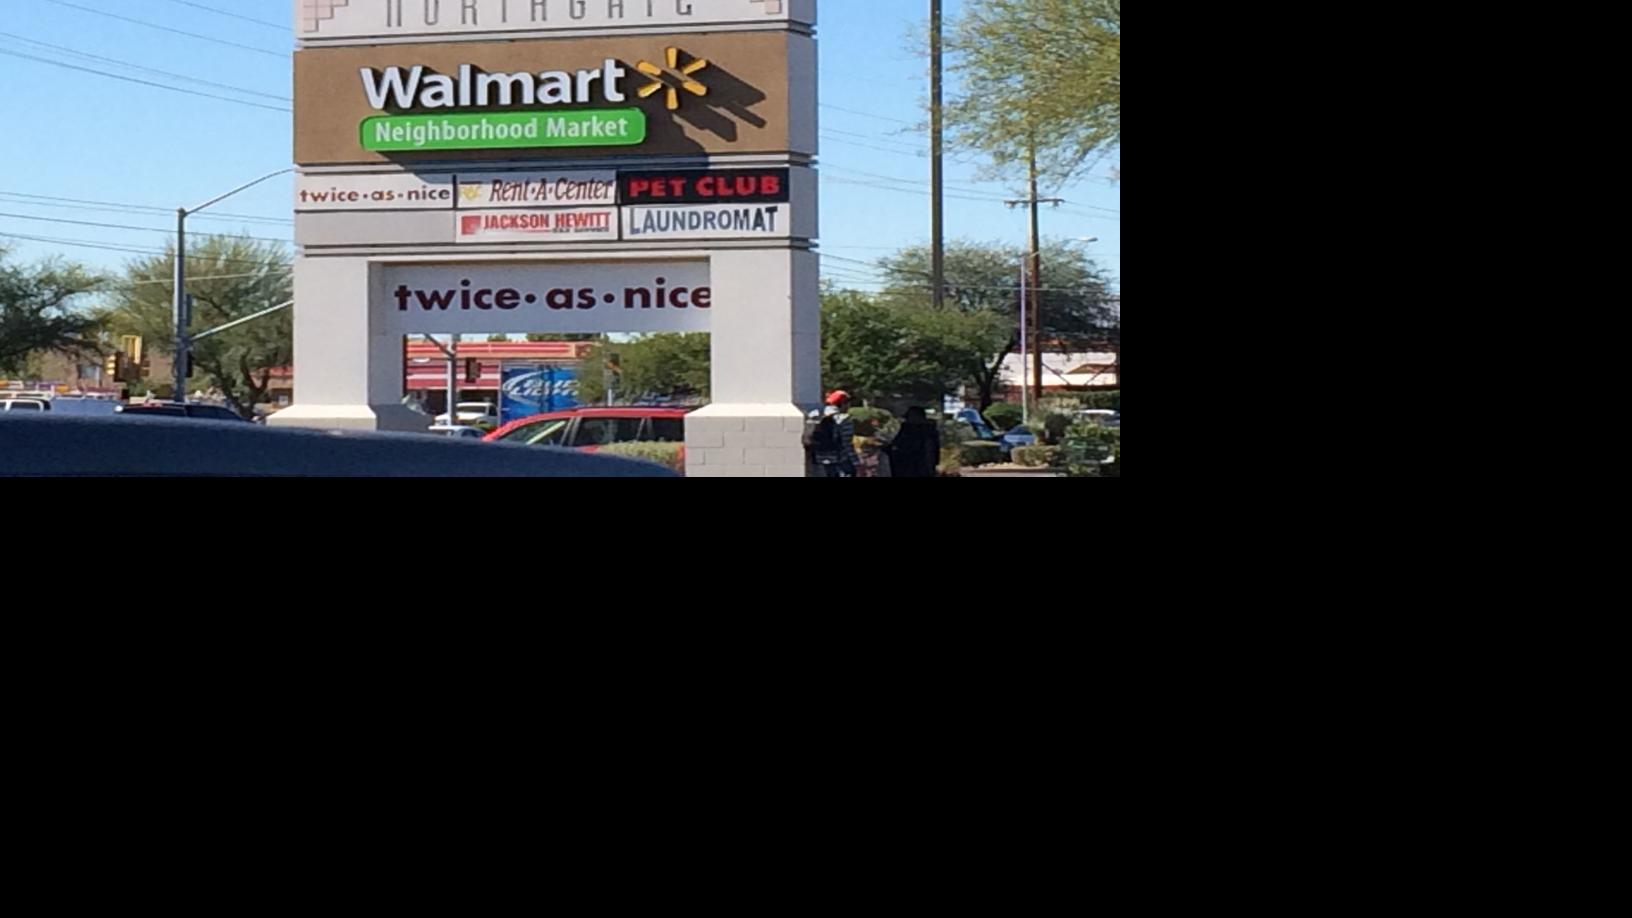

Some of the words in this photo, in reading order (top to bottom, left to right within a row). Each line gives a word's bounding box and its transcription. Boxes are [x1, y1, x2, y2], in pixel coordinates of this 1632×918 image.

[360, 59, 625, 109] Walmart
[375, 117, 538, 147] Neighborhood
[546, 117, 629, 138] Market
[629, 177, 686, 197] PET
[695, 175, 780, 196] CLUB
[484, 213, 549, 229] JACKSON
[555, 212, 611, 228] HEWITT
[629, 206, 778, 235] LAUNDROMAT
